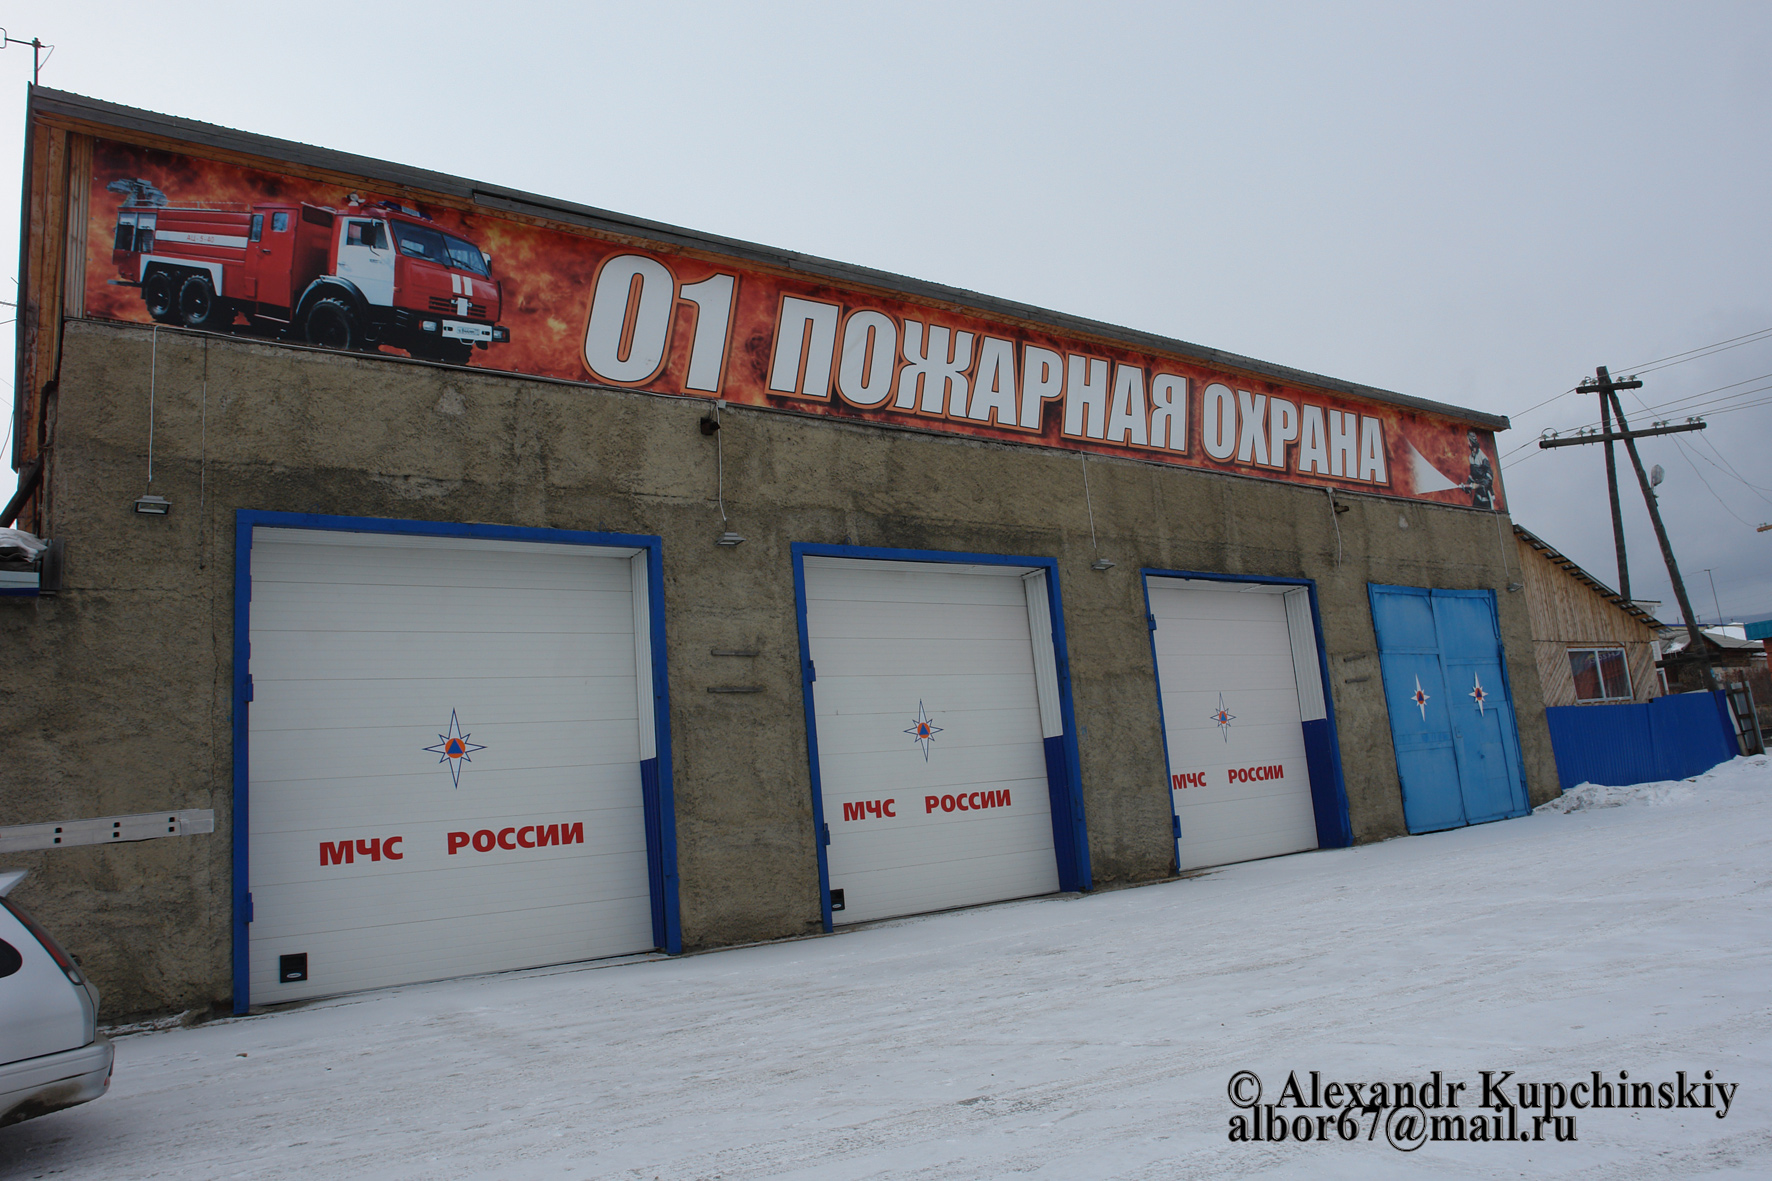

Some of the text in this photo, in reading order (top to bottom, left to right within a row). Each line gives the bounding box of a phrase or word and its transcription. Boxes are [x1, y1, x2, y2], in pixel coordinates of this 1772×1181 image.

[767, 295, 1190, 454] ПОЖАРНАЯ
[1201, 381, 1389, 486] ОХРАНА
[1172, 765, 1283, 789] МЧС РОССИИ
[844, 789, 1011, 821] МЧС РОССИИ
[320, 822, 584, 866] МЧС РОССИИ
